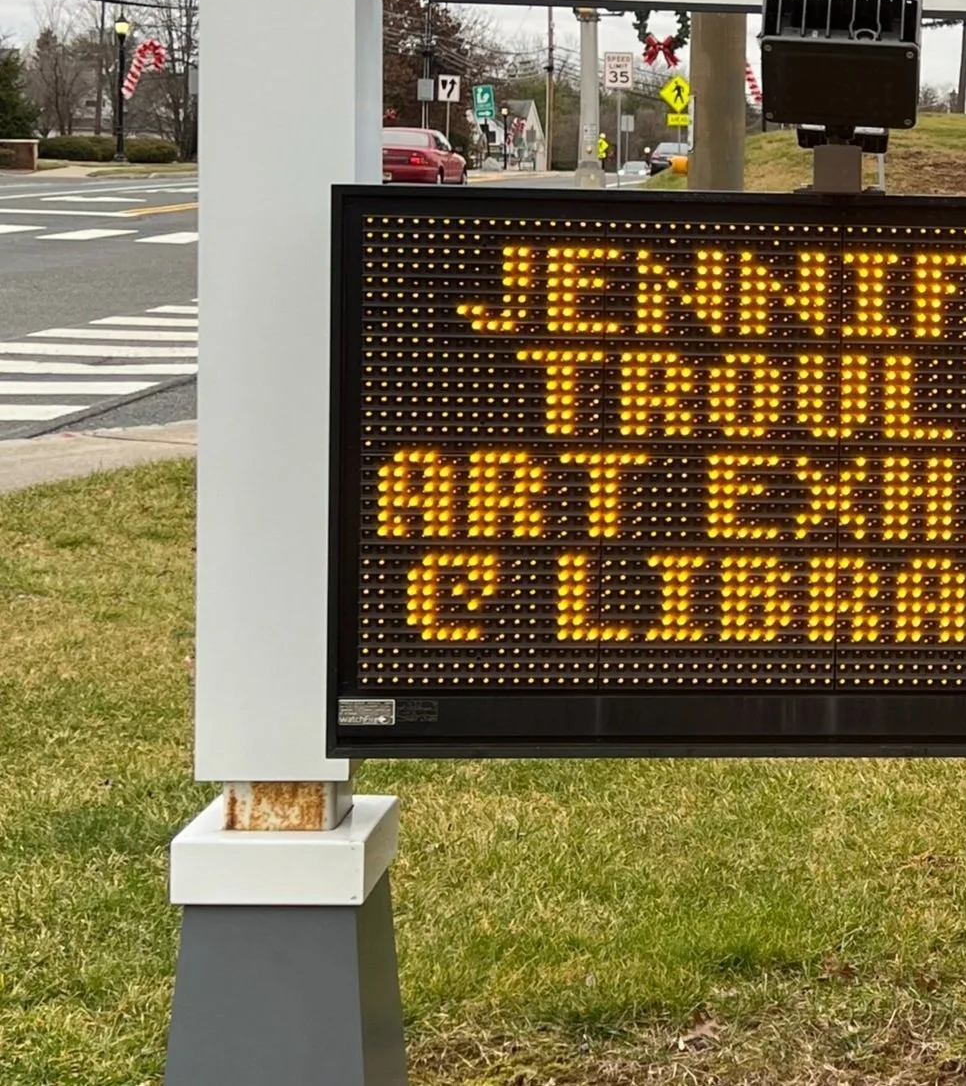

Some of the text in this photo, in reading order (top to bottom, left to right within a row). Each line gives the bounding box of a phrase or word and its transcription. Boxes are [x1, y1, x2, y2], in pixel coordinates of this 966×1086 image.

[609, 71, 629, 83] 35
[375, 450, 648, 540] ART
[406, 552, 501, 643] @
